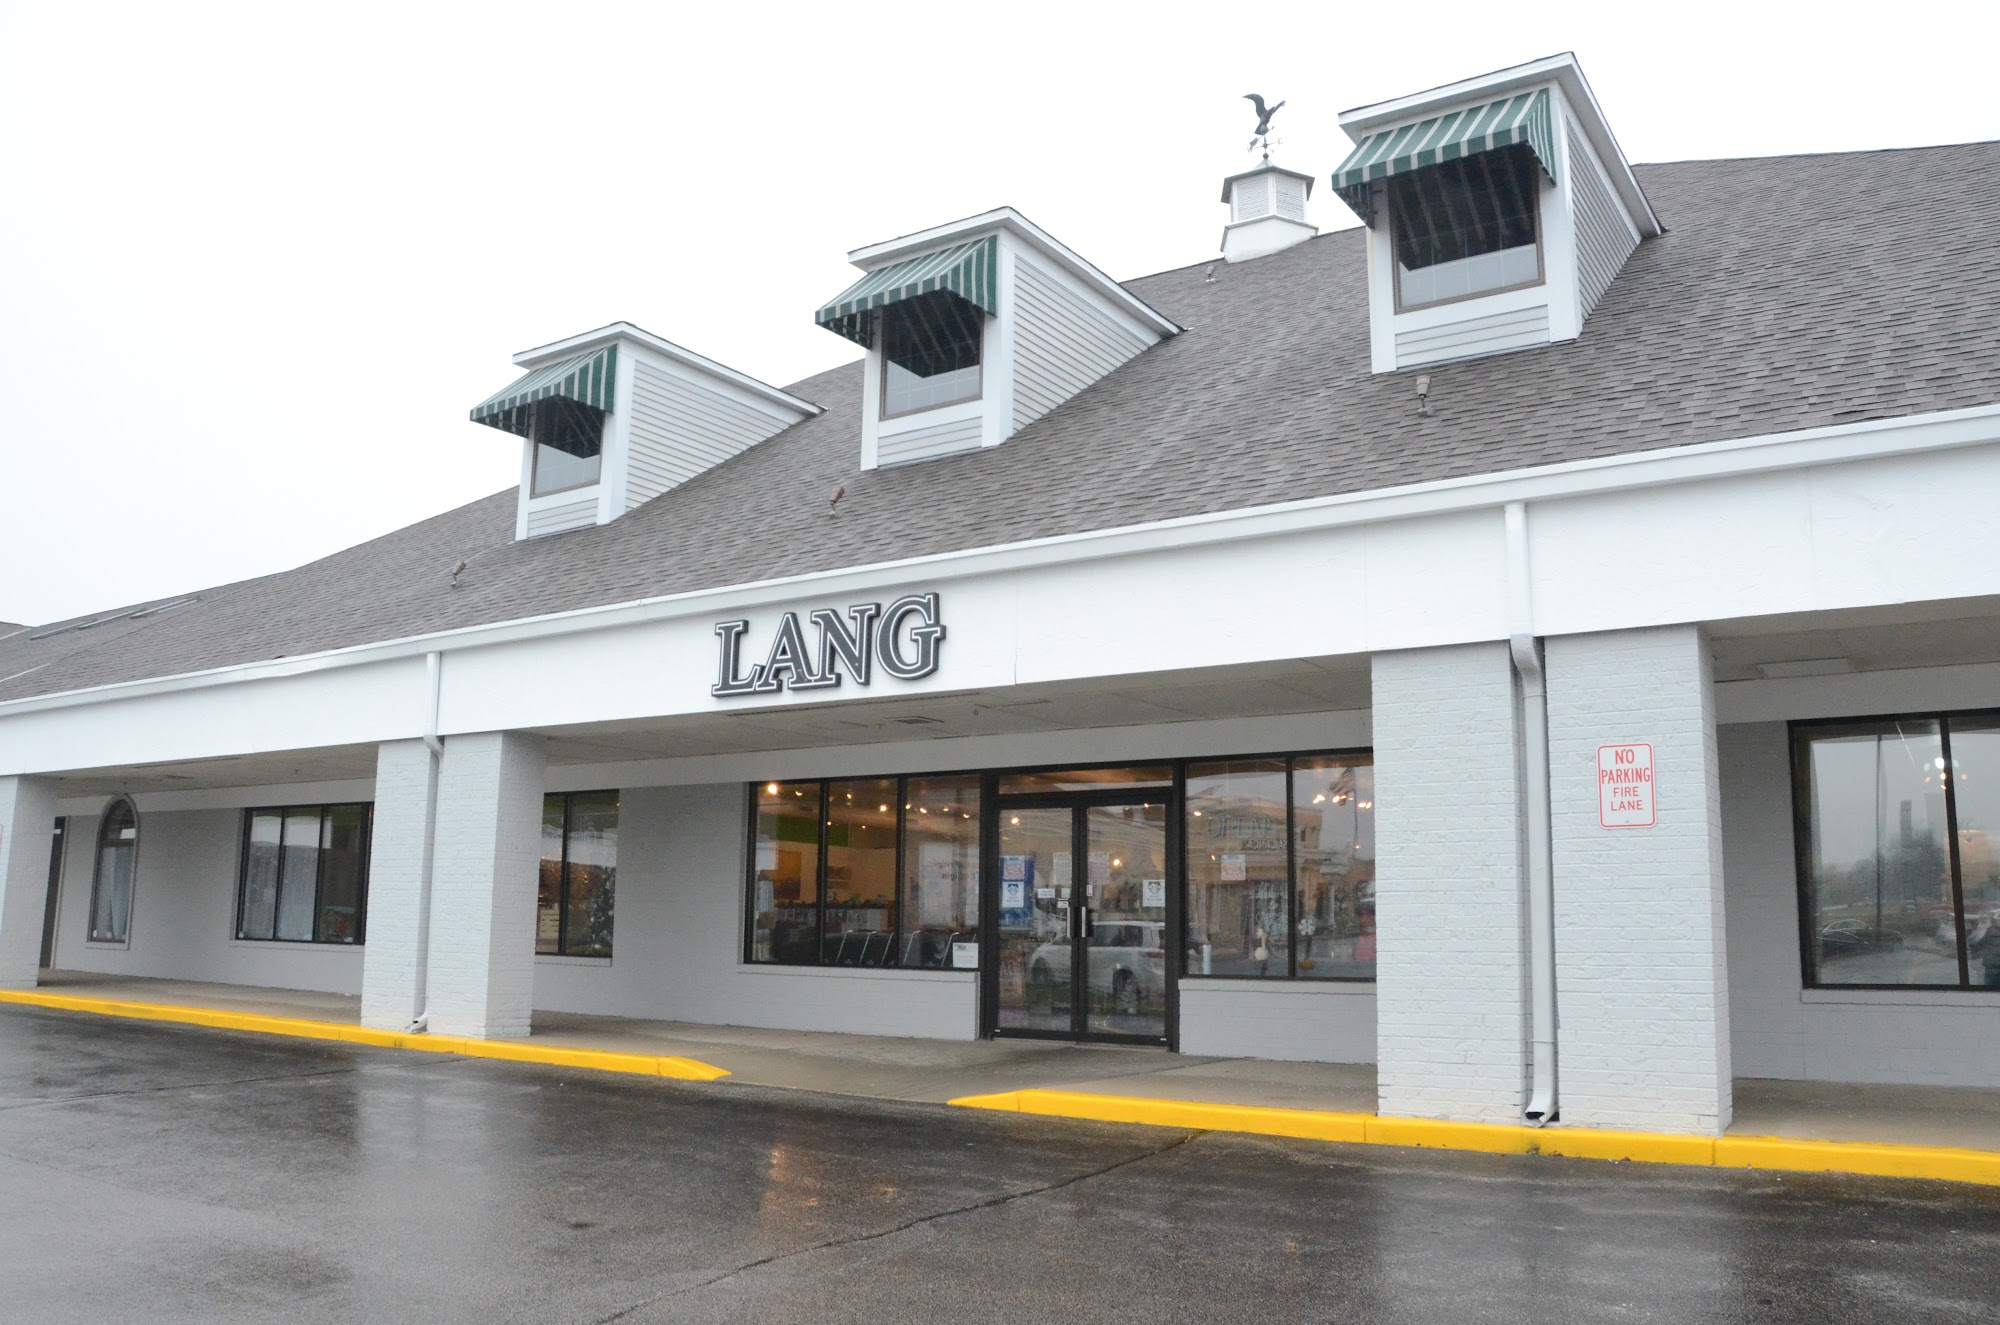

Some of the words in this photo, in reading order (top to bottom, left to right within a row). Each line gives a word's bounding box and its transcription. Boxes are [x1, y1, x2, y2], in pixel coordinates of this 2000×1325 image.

[711, 592, 946, 697] LANG
[1615, 749, 1635, 765] NO
[1601, 767, 1650, 785] PARKING
[1613, 786, 1639, 798] FIRE
[1610, 799, 1643, 812] LANE
